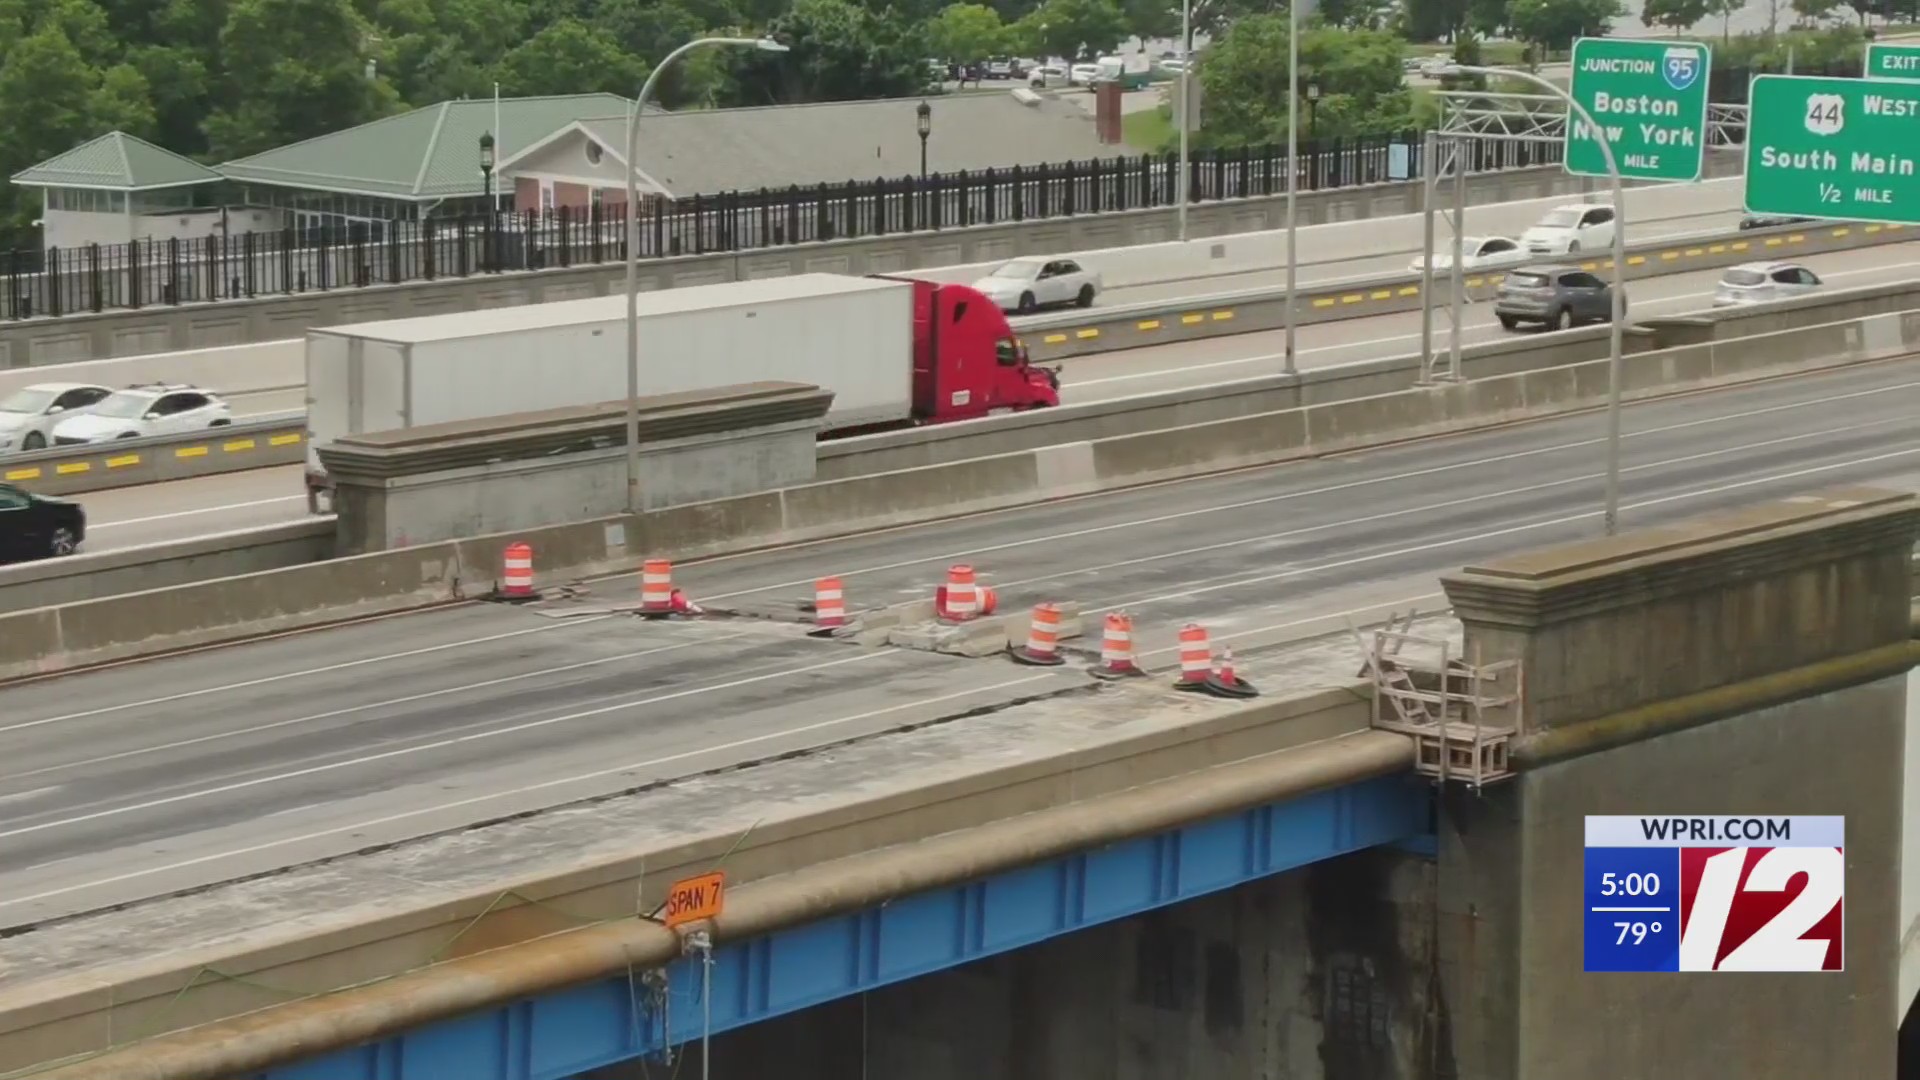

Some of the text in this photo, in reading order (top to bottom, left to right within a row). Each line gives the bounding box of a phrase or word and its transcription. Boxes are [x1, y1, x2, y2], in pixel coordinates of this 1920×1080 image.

[1580, 58, 1656, 75] JUNCTION
[1670, 59, 1693, 79] 95
[1882, 55, 1920, 70] EXIT
[1594, 91, 1679, 117] Boston
[1809, 102, 1839, 125] 44
[1863, 94, 1919, 117] WEST
[1639, 122, 1695, 147] York
[1624, 154, 1660, 170] MILE
[1760, 146, 1915, 176] South Main
[1854, 187, 1893, 204] MILE
[669, 882, 721, 916] SPAN 7
